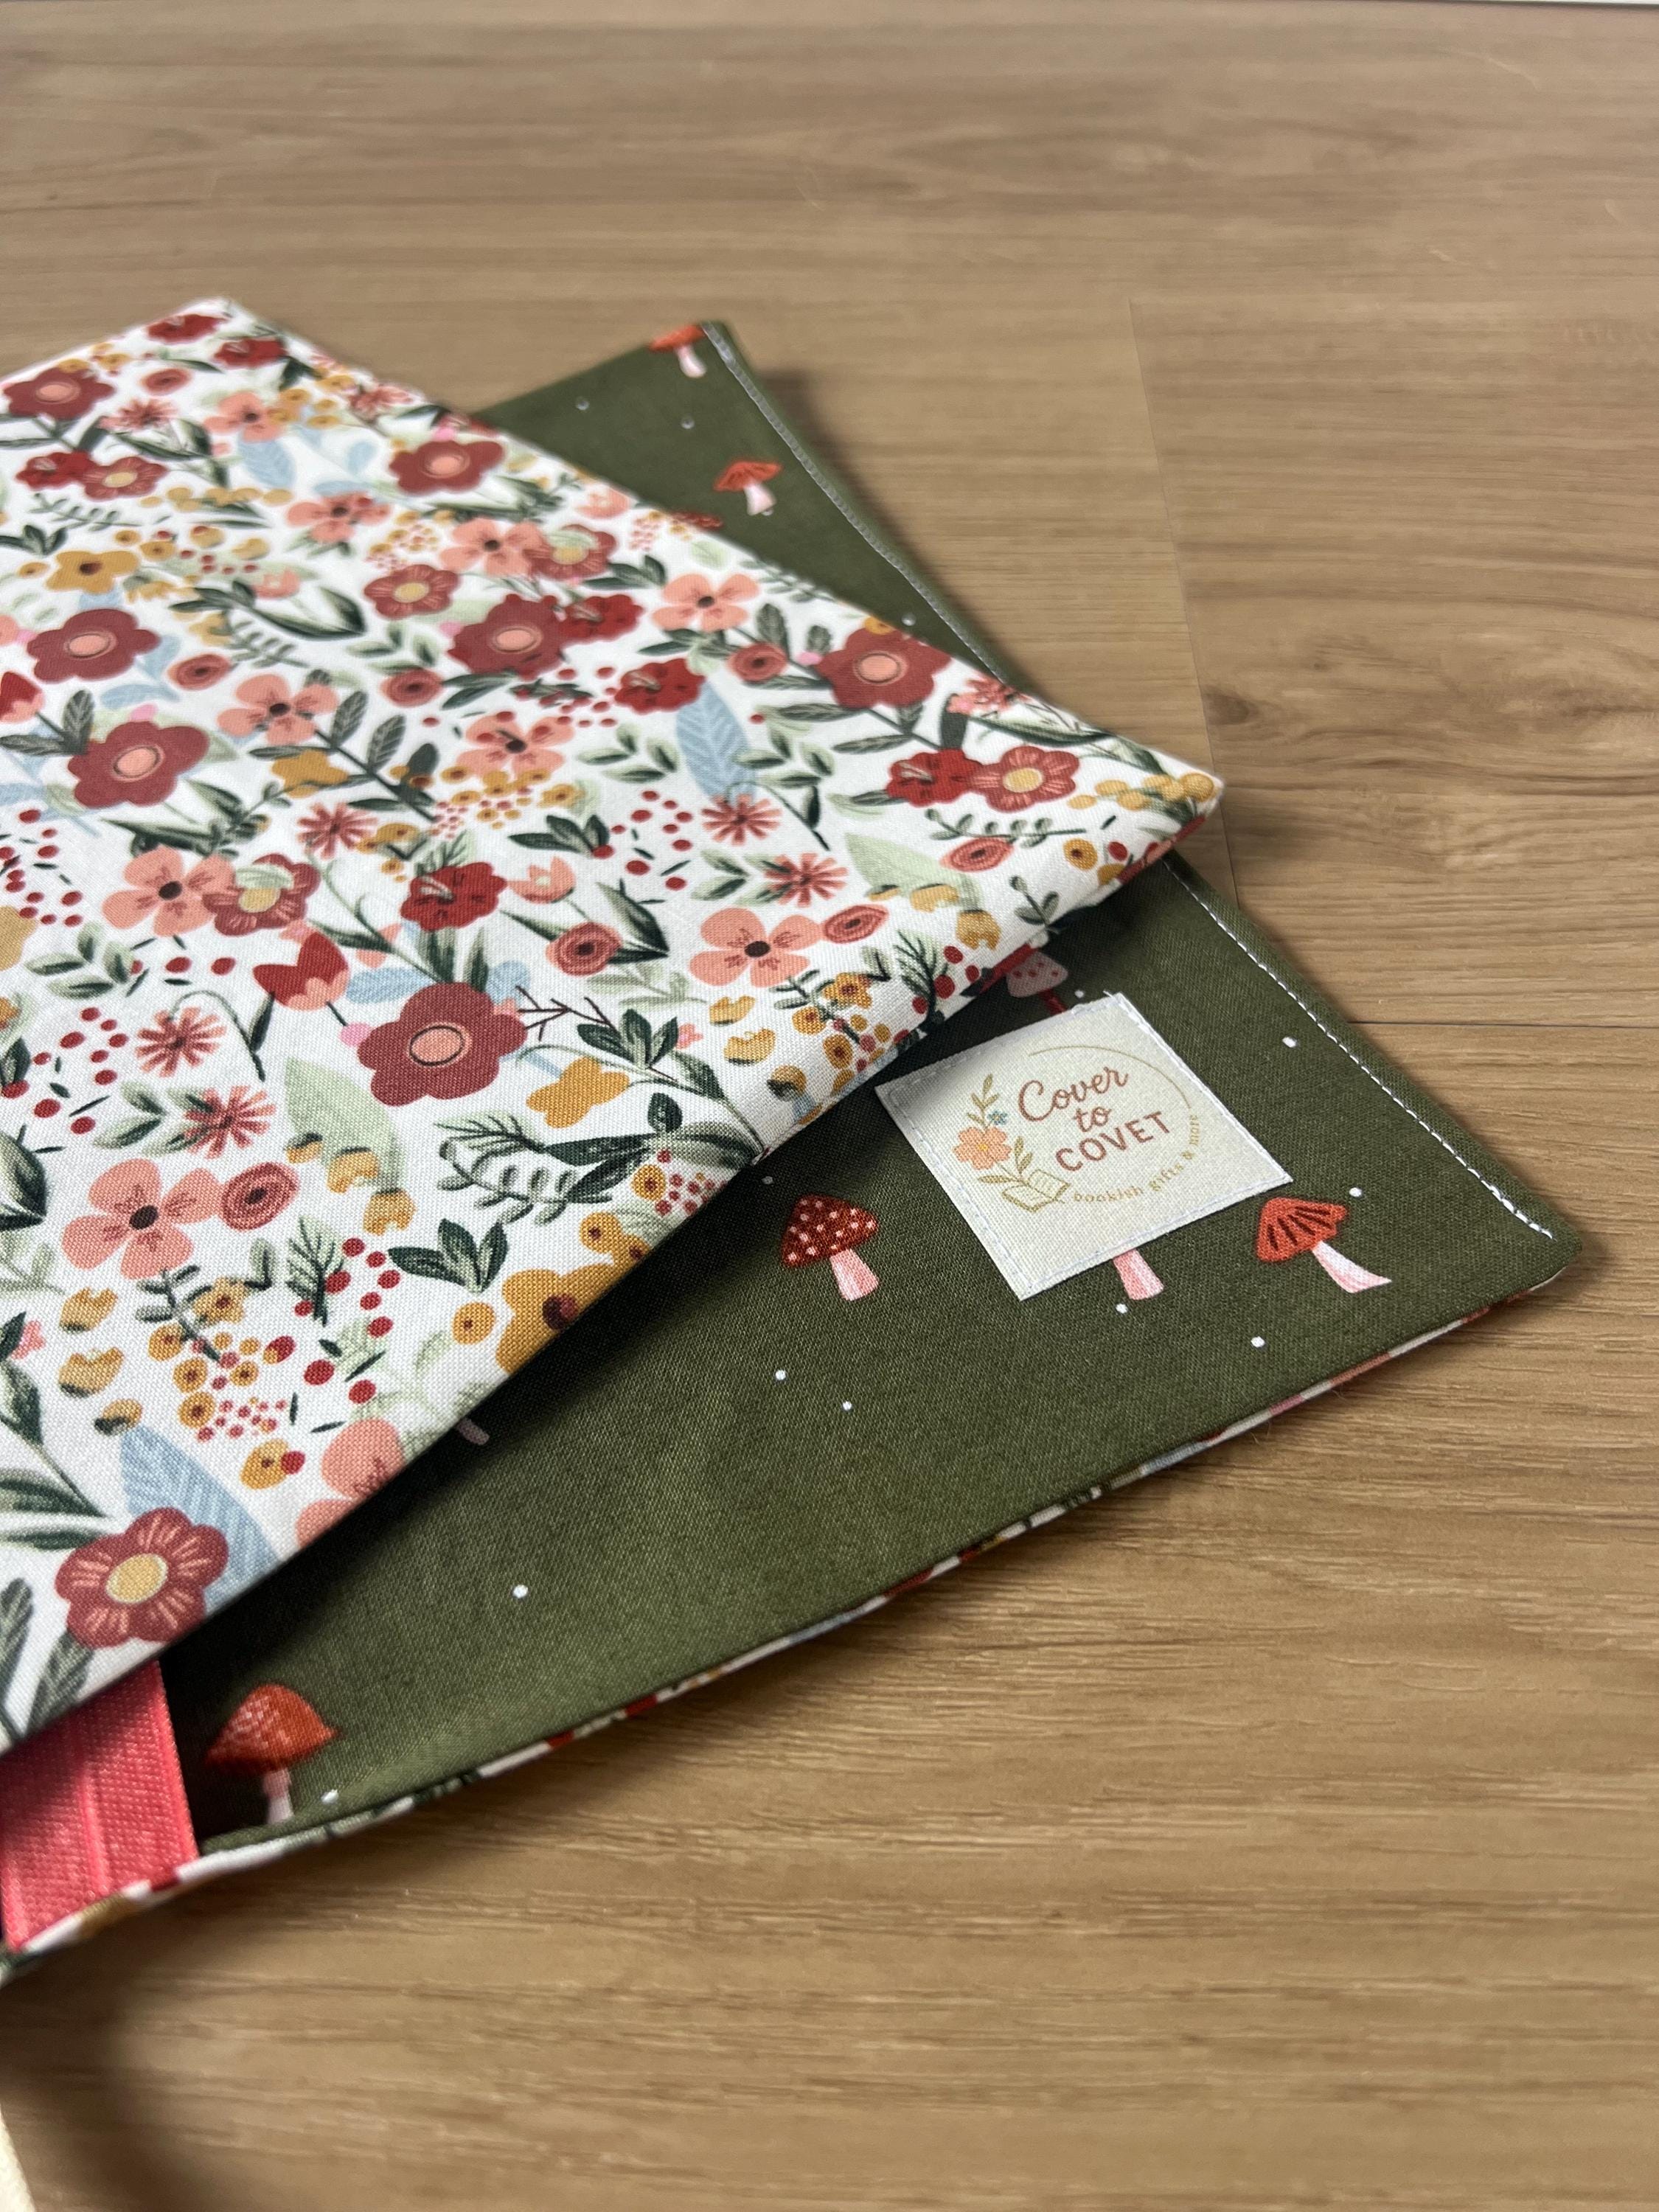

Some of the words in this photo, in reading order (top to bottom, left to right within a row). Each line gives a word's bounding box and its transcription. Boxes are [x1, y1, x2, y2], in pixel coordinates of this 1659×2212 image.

[1018, 1066, 1130, 1121] Cover
[1074, 1106, 1113, 1133] to
[1055, 1111, 1170, 1172] COVET
[1074, 1185, 1144, 1203] bookish
[1148, 1163, 1184, 1192] gifts
[1189, 1113, 1201, 1147] more
